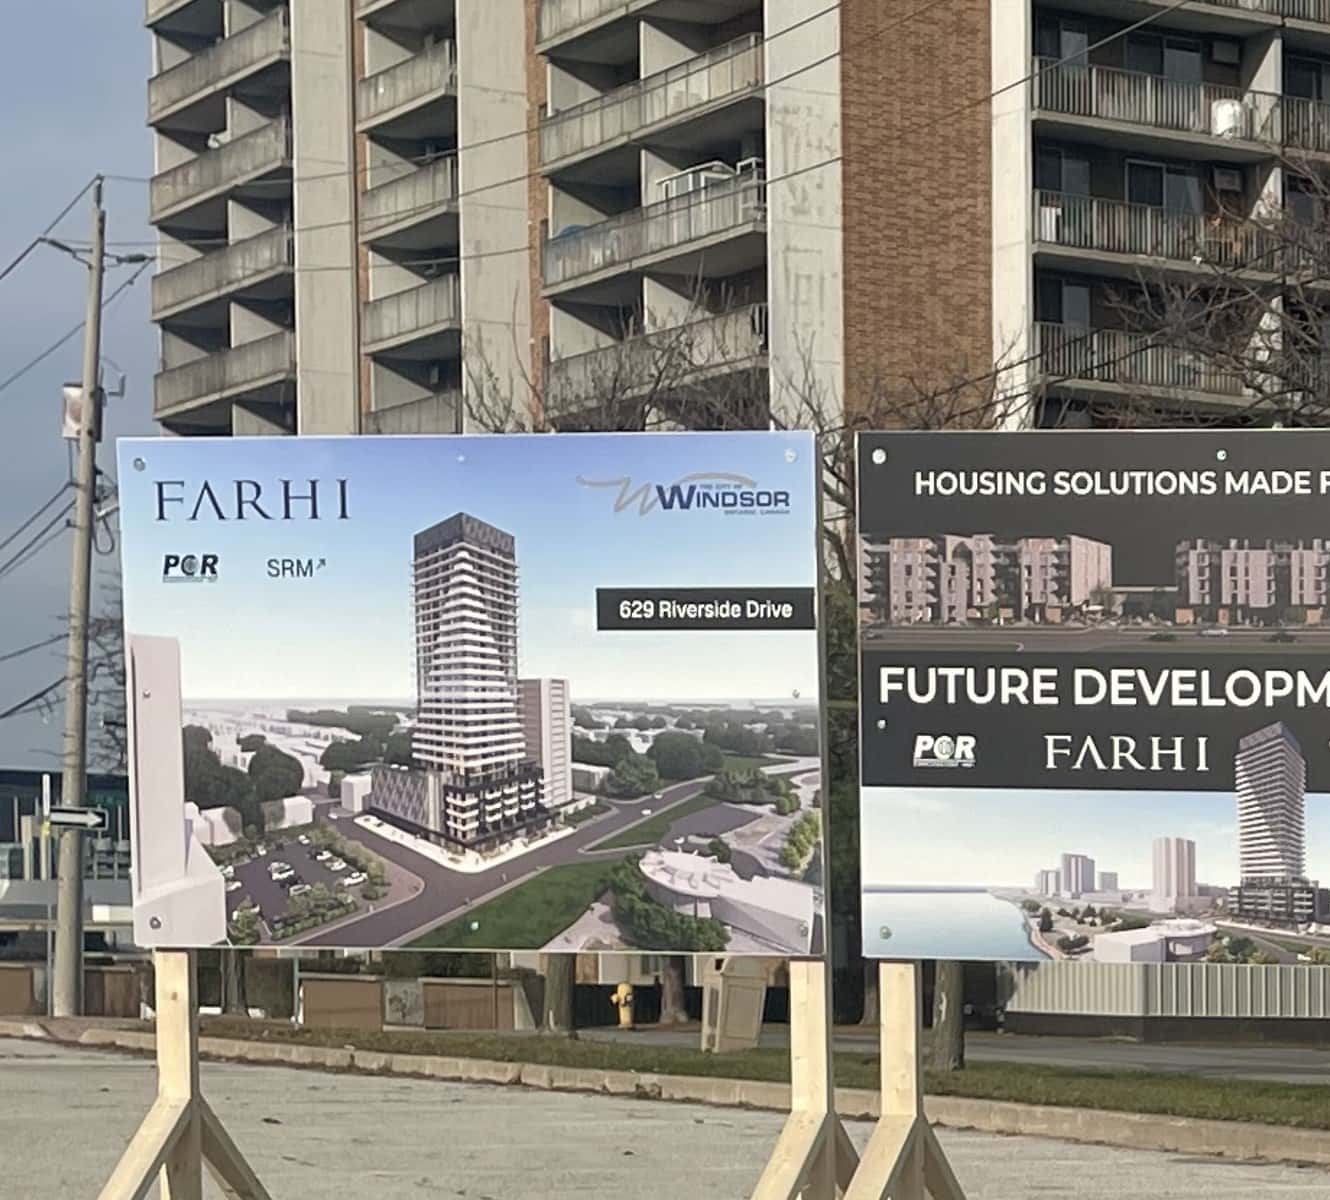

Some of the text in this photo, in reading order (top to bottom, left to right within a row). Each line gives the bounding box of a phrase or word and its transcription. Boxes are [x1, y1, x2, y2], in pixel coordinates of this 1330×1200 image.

[915, 471, 1046, 495] HOUSING
[1053, 471, 1217, 495] SOLUTIONS
[1225, 470, 1311, 494] MADE
[154, 479, 351, 521] FARHI
[656, 485, 790, 509] WINDSOR
[267, 558, 314, 578] SRM
[619, 599, 792, 619] 629 Riverside Drive
[880, 667, 1059, 704] FUTURE
[1044, 735, 1209, 771] FARHI
